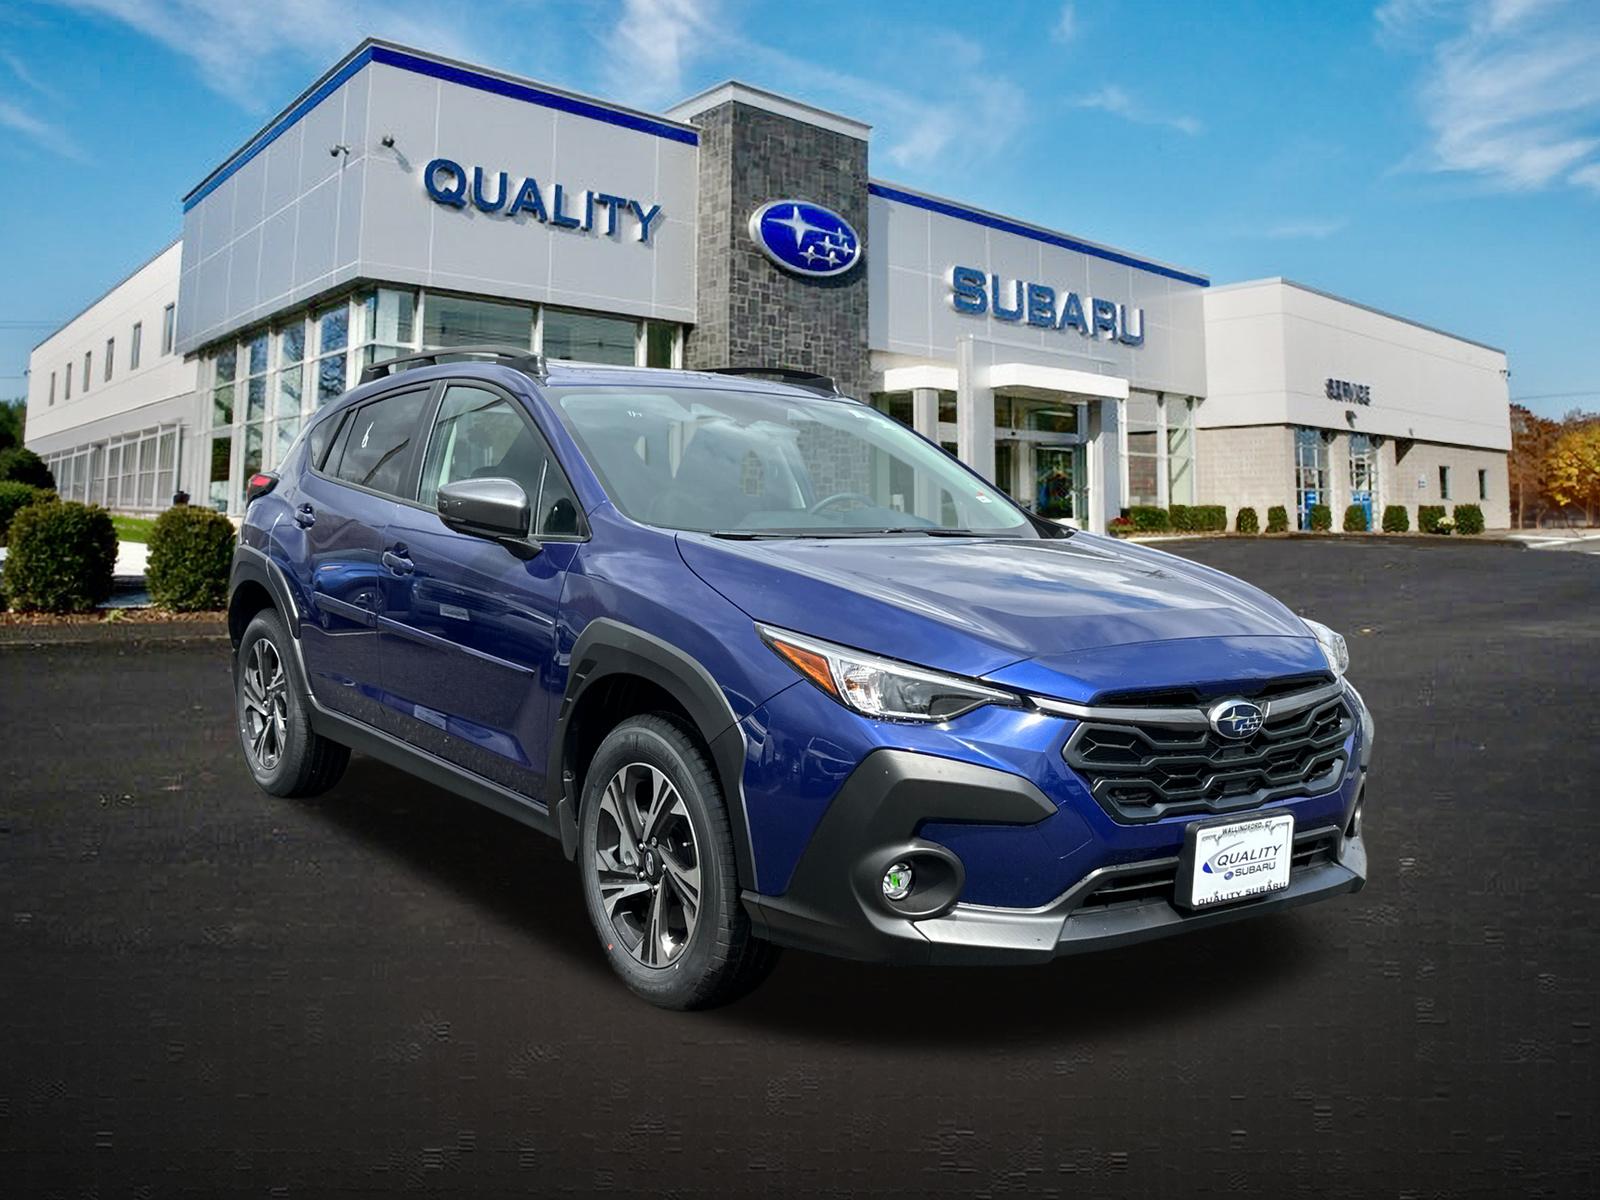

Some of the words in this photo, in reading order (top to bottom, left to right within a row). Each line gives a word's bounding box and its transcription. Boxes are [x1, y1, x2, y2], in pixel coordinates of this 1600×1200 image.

[424, 158, 662, 243] QUALITY
[952, 265, 1145, 347] SUBARU
[1217, 844, 1282, 866] QUALITY
[1235, 862, 1276, 877] SUBARU
[1199, 891, 1241, 905] QUALITY
[1246, 881, 1286, 896] SUBARU
